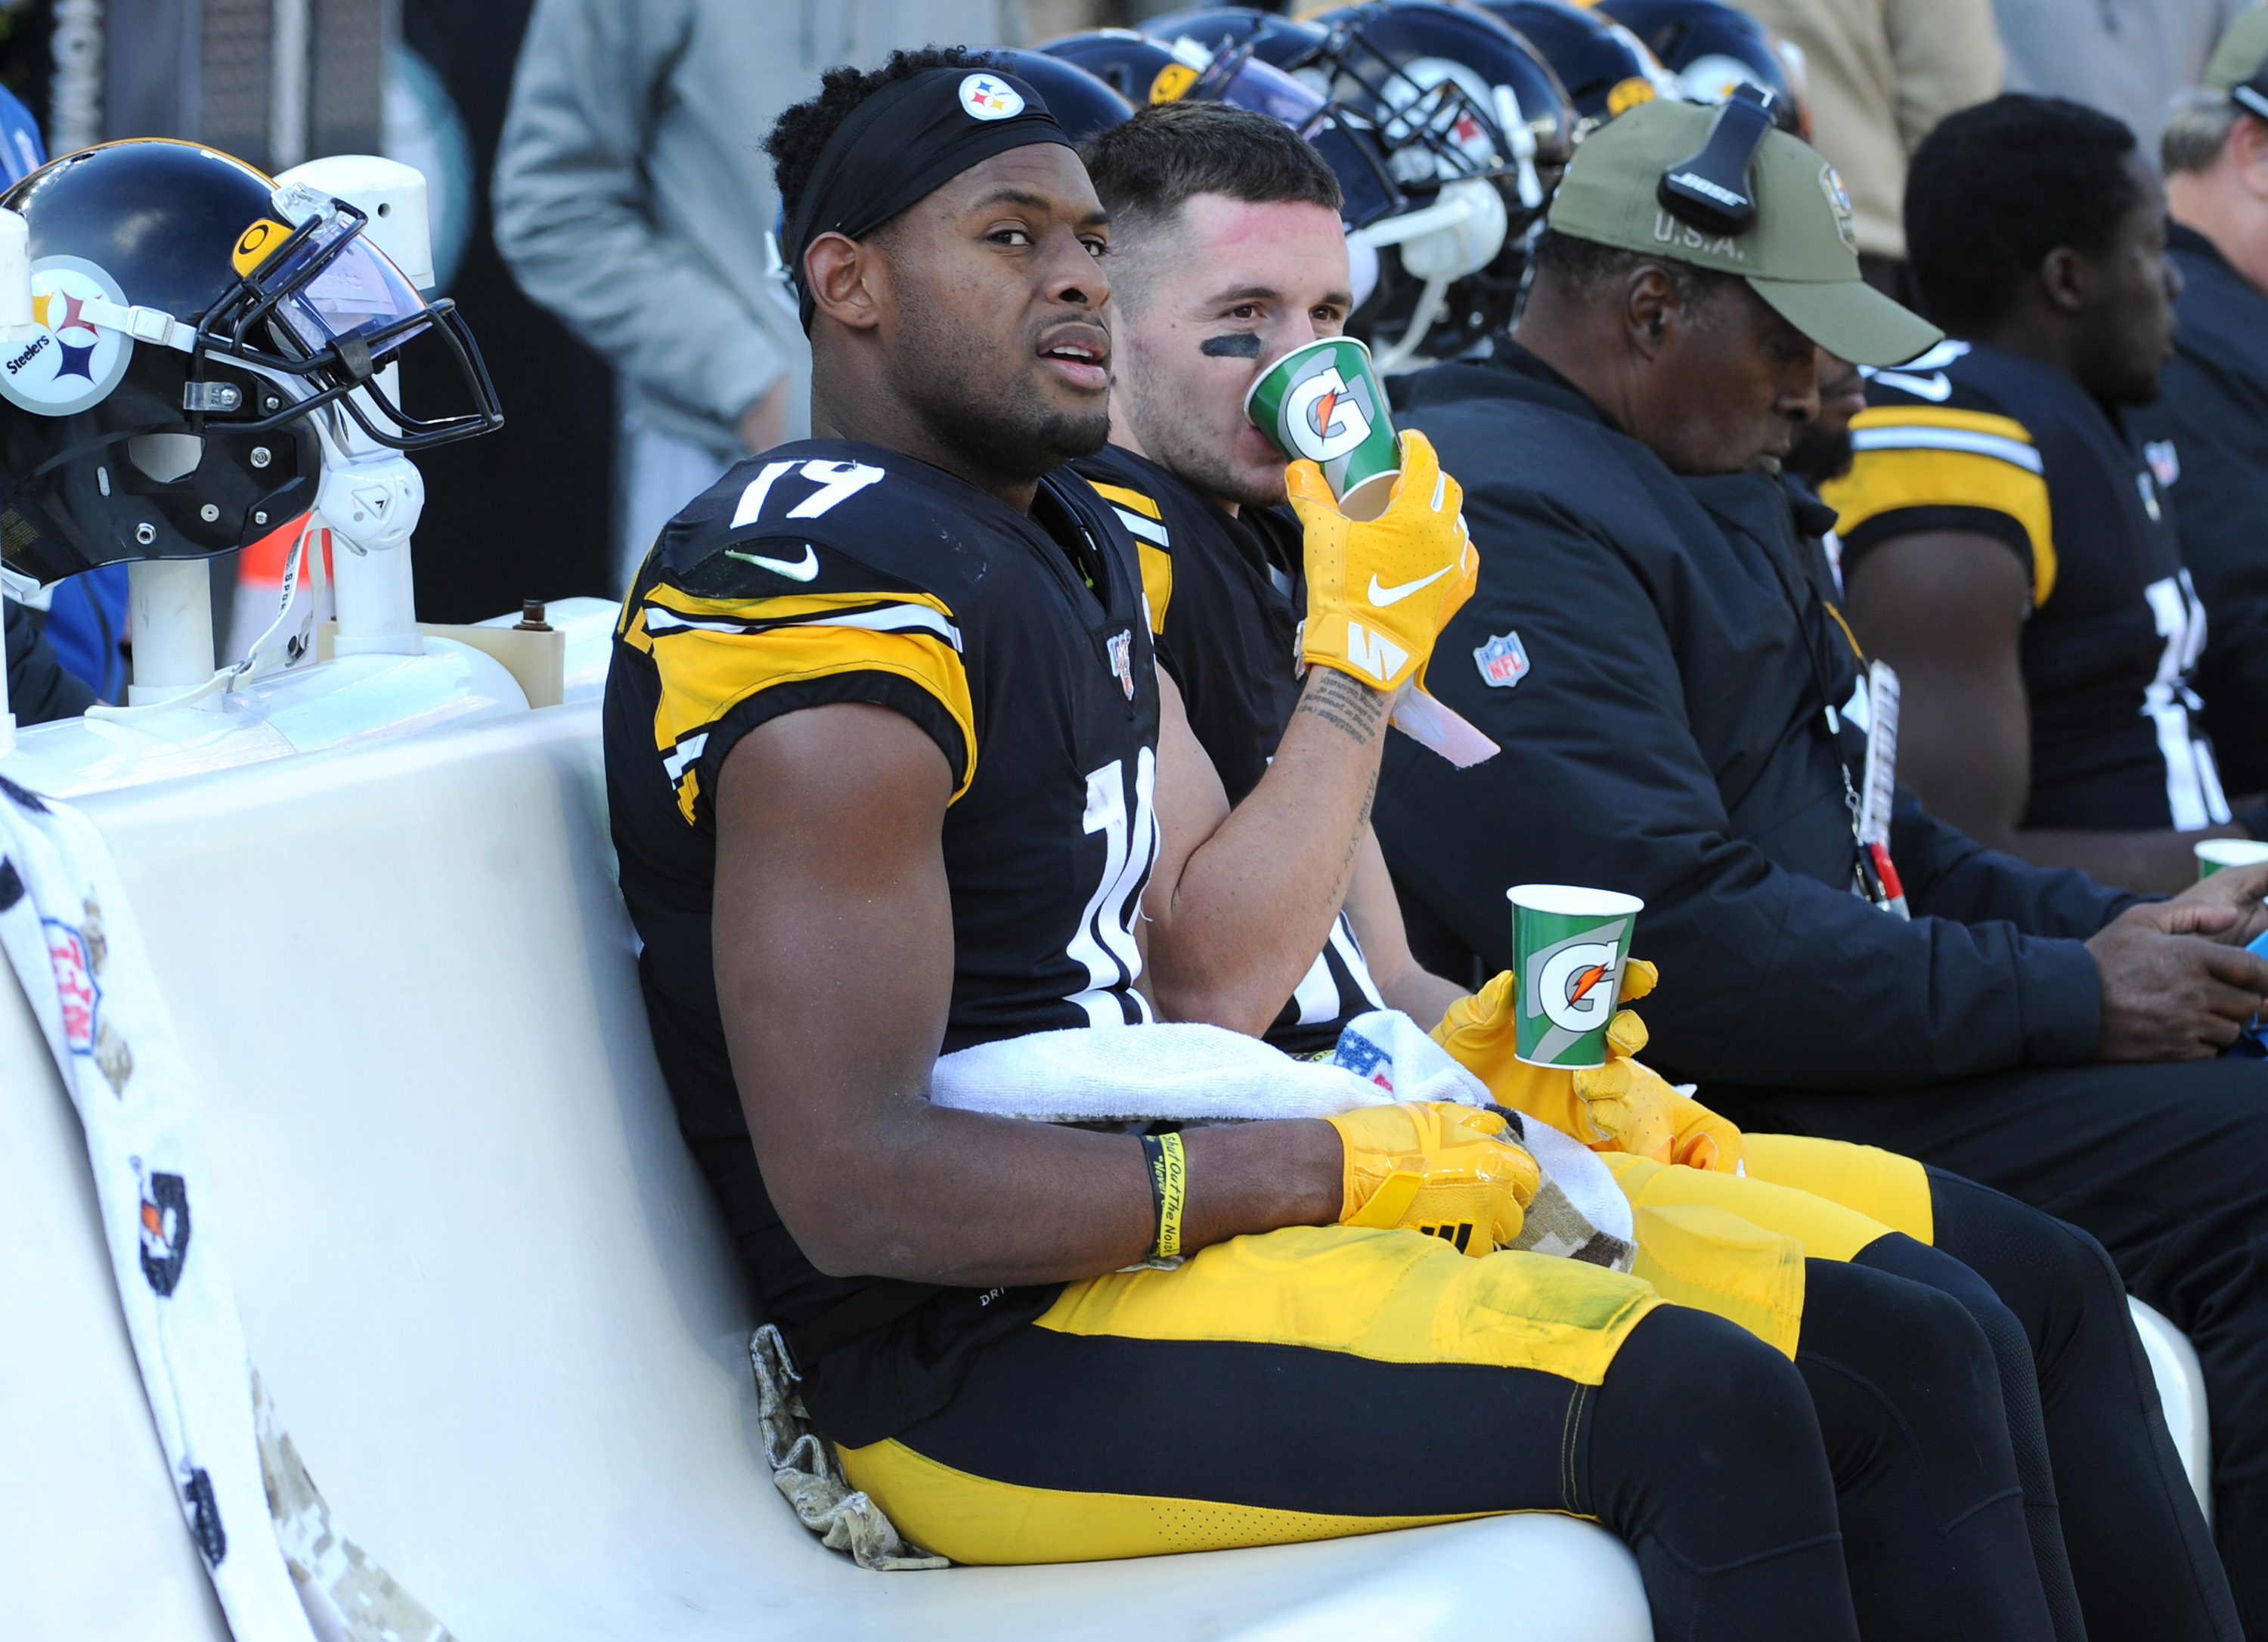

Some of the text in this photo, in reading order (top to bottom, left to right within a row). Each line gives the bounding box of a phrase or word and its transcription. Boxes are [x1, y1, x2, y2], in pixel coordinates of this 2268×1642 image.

[1668, 172, 1749, 207] BOSE
[6, 335, 50, 375] Steelers
[1285, 366, 1373, 463] G
[729, 458, 886, 530] 19
[1488, 651, 1524, 680] NFL
[1538, 938, 1620, 1033] G
[1163, 1135, 1181, 1161] Shut
[1170, 1162, 1182, 1194] Out
[1166, 1194, 1179, 1220] The
